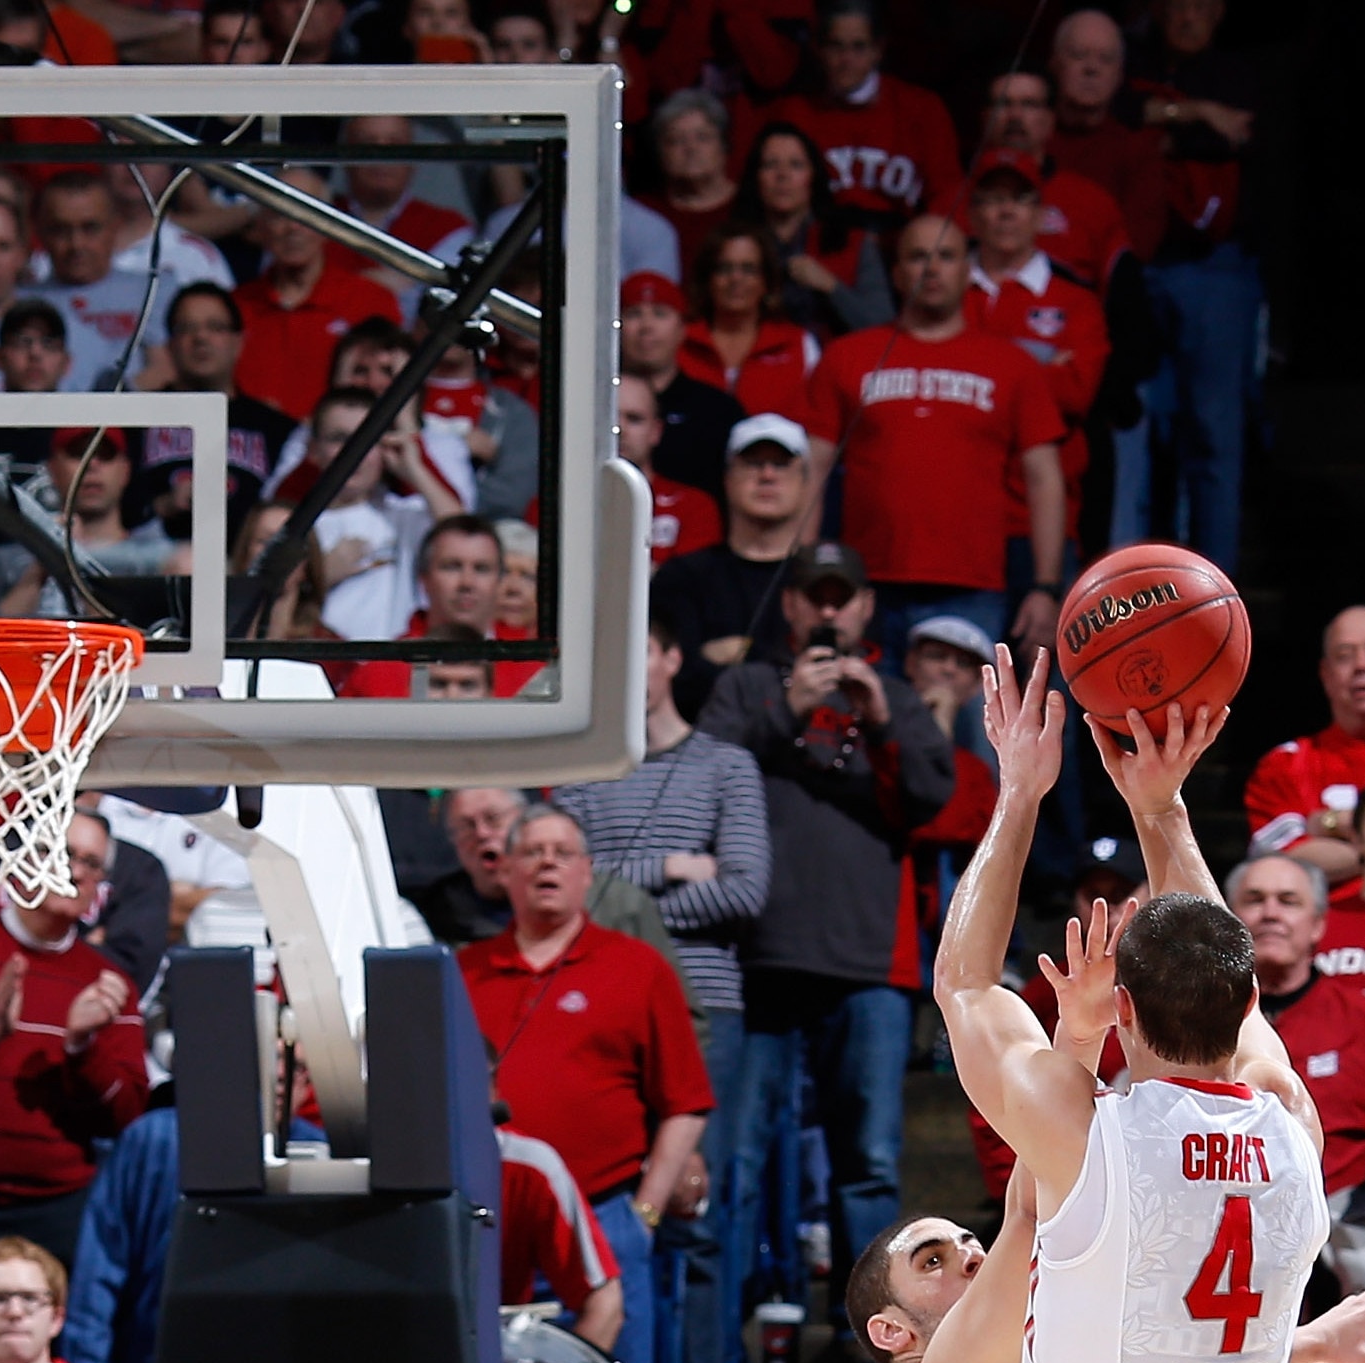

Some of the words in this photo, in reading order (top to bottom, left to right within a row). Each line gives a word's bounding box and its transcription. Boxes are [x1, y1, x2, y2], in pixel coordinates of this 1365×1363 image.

[920, 369, 996, 412] STATE
[1064, 583, 1179, 657] Wilson
[1181, 1132, 1271, 1184] CRAFT
[1183, 1193, 1263, 1355] 4
